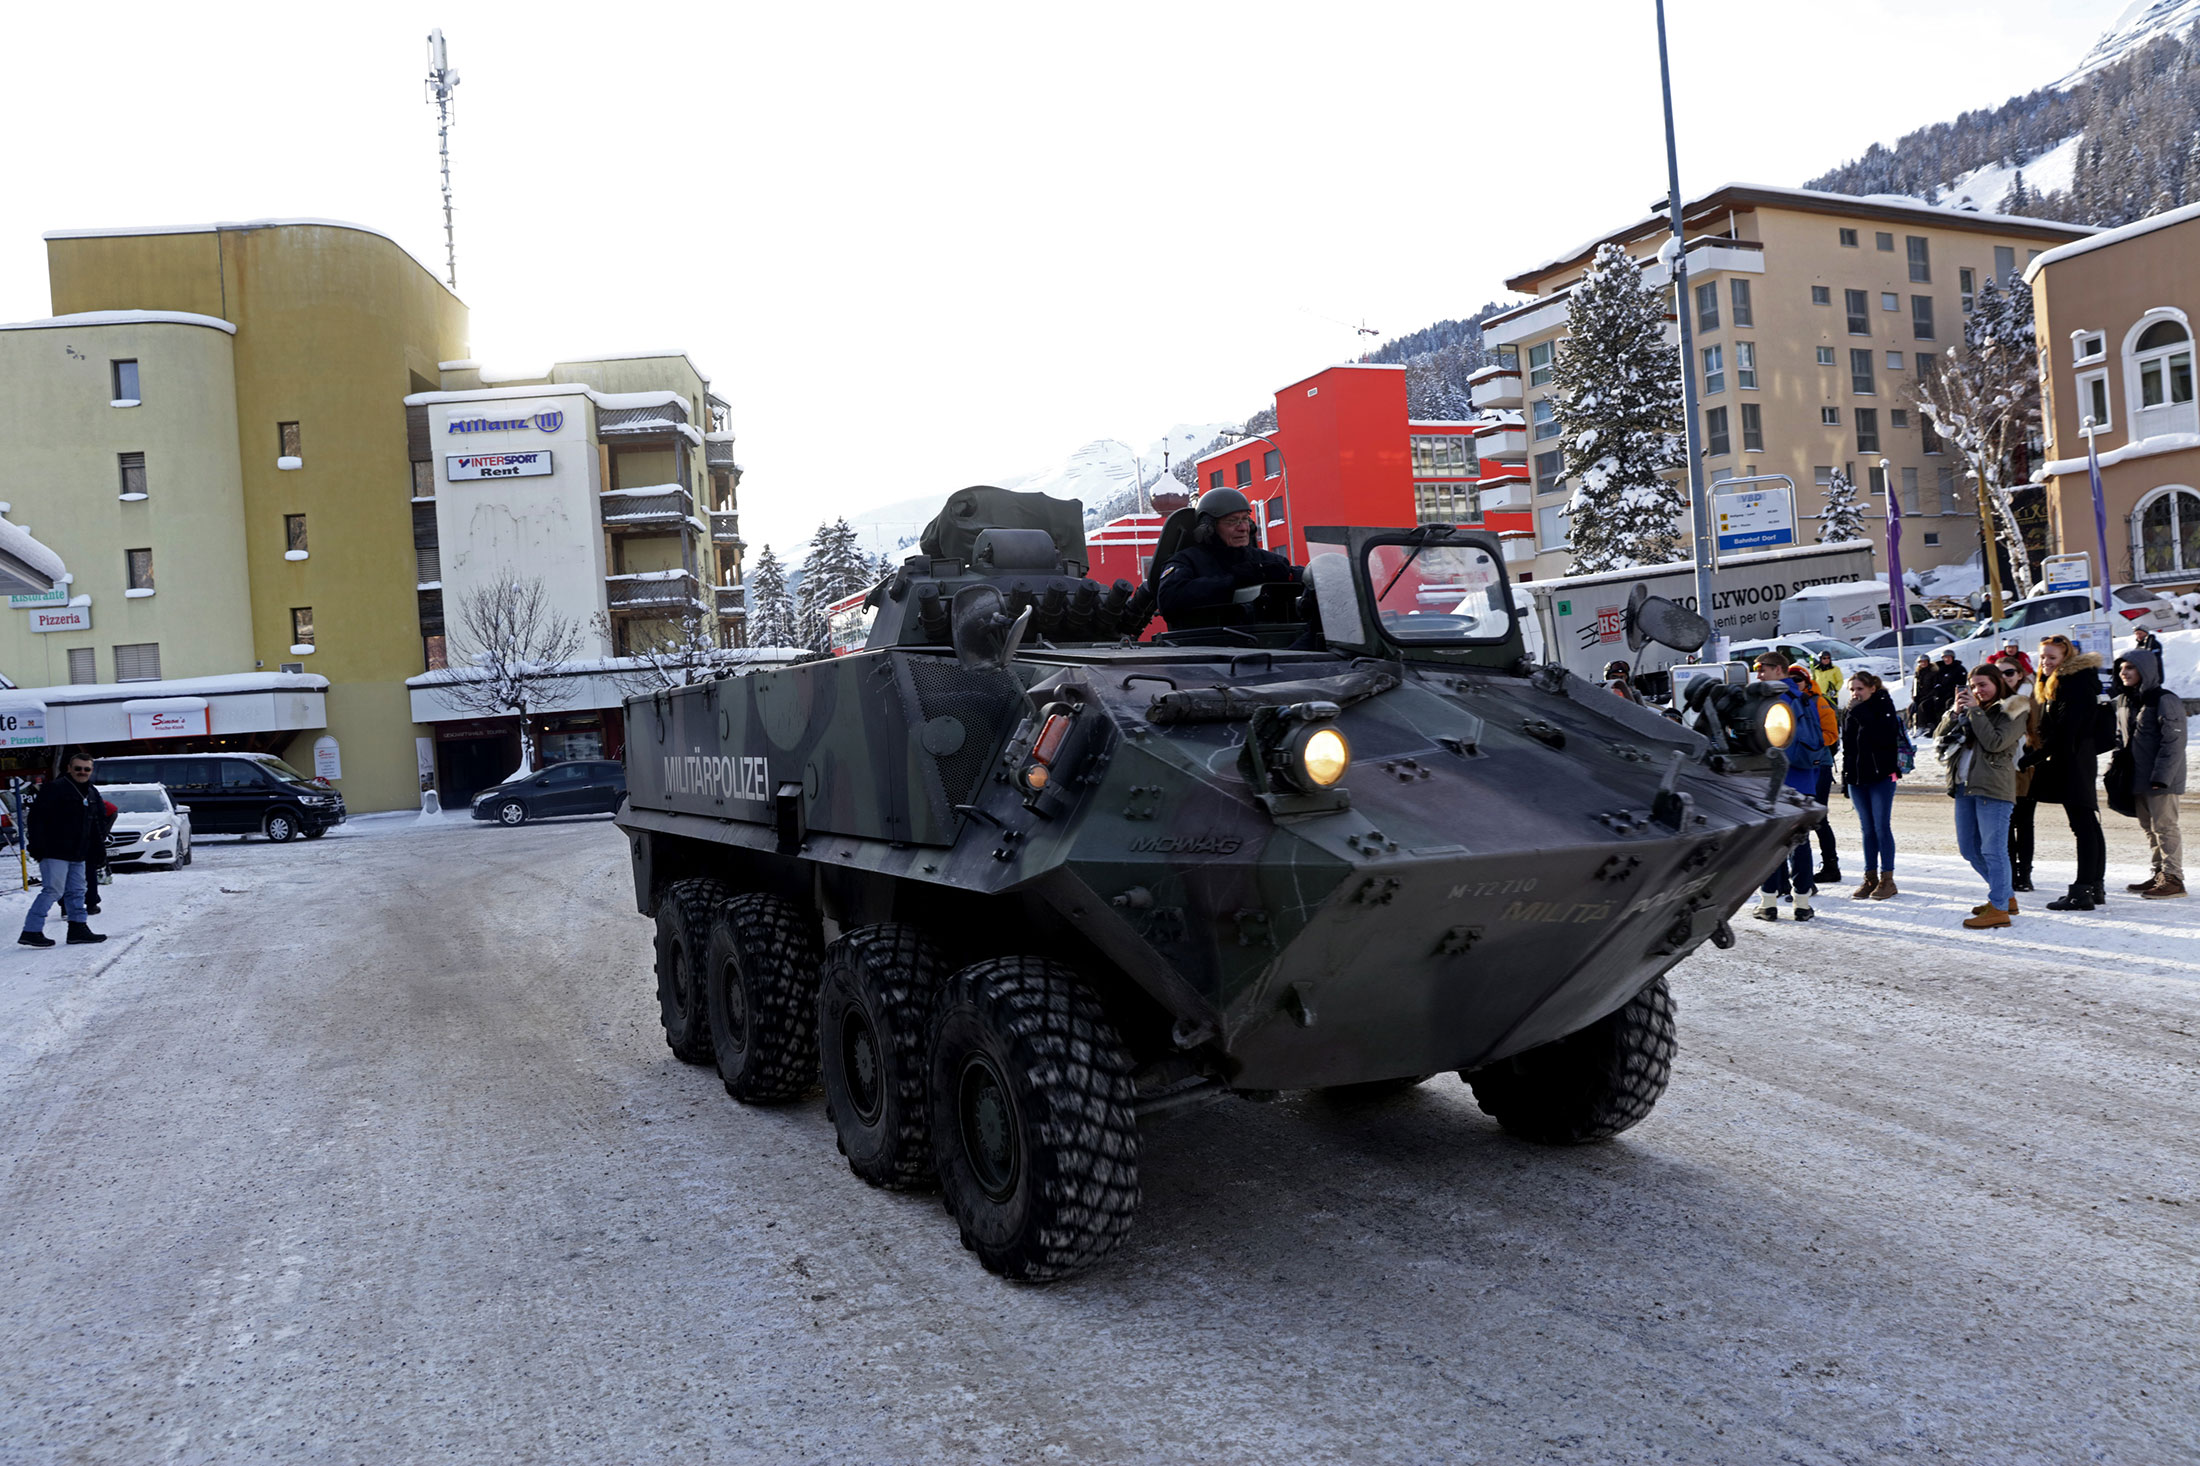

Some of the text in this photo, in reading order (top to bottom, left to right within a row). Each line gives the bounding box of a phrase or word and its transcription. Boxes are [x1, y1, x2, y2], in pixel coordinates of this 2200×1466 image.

[471, 454, 538, 467] INTERSPORT
[480, 466, 520, 477] Rent
[1741, 493, 1762, 502] VBD
[1734, 534, 1776, 544] Bahnhof Dorf
[1671, 584, 1787, 612] OLYWOOD
[39, 613, 80, 626] Pizzeria
[1600, 615, 1619, 633] HS
[1740, 613, 1757, 627] per
[1760, 610, 1770, 621] lo
[10, 736, 44, 745] Pizzeria
[664, 746, 770, 801] MILITÄRPOLIZEI
[1129, 836, 1243, 855] MOWAG
